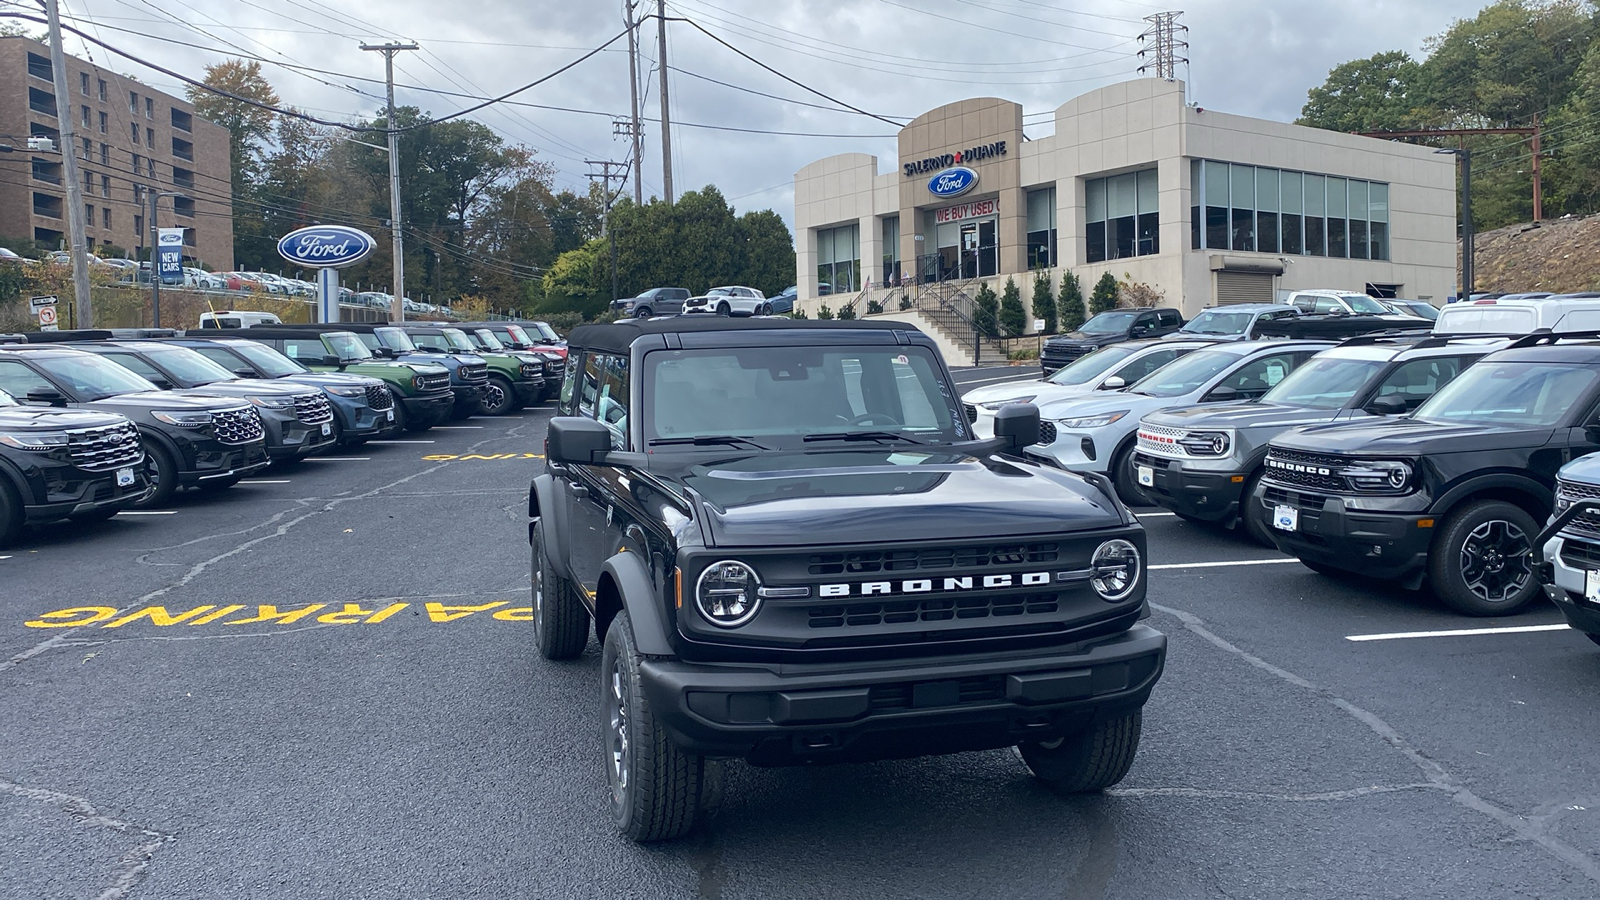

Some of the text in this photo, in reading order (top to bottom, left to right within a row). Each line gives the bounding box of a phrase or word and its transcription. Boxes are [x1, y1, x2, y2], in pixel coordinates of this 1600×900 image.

[904, 141, 1007, 177] SALERNO DUANE
[936, 172, 964, 192] Ford
[937, 209, 950, 222] WE
[952, 205, 969, 220] BUY
[971, 201, 994, 216] USED
[296, 234, 350, 258] Ford
[161, 252, 179, 263] NEW
[162, 262, 180, 272] CARS
[1138, 432, 1174, 444] BRONCO
[1269, 460, 1330, 475] BRONCO
[819, 571, 1051, 597] BRONCO
